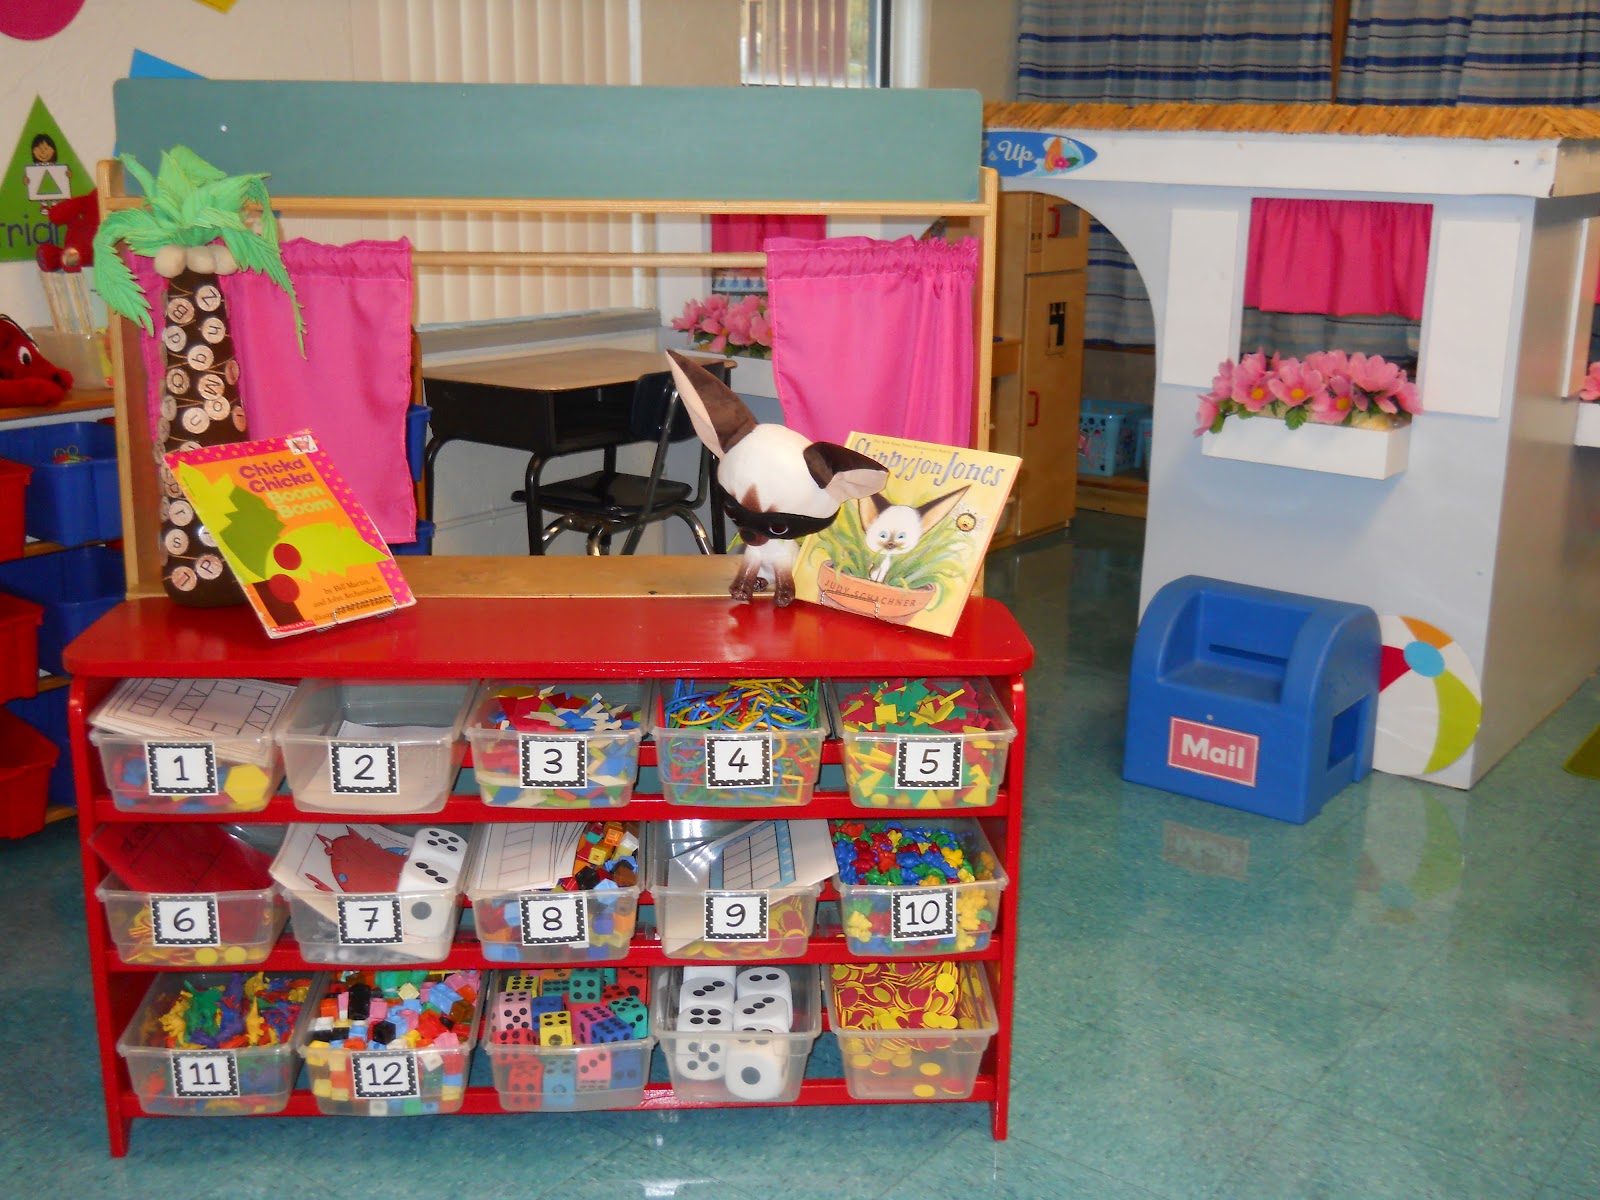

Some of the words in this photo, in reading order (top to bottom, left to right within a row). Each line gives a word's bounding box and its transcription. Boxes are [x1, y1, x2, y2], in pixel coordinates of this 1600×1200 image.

[997, 140, 1035, 169] Up
[239, 459, 306, 479] Chicka
[933, 451, 1006, 487] Jones
[249, 472, 315, 493] Chicka
[266, 486, 325, 505] Boom
[277, 499, 335, 519] Boom
[824, 579, 851, 593] JUDY
[543, 748, 563, 775] 3
[727, 747, 750, 774] 4
[919, 748, 941, 775] 5
[1181, 733, 1245, 769] Mail
[173, 755, 190, 782] 1
[353, 754, 375, 781] 2
[173, 907, 195, 933] 6
[358, 906, 379, 932] 7
[541, 906, 563, 932] 8
[725, 903, 747, 928] 9
[905, 899, 941, 926] 10
[189, 1062, 221, 1086] 11
[365, 1061, 404, 1086] 12
